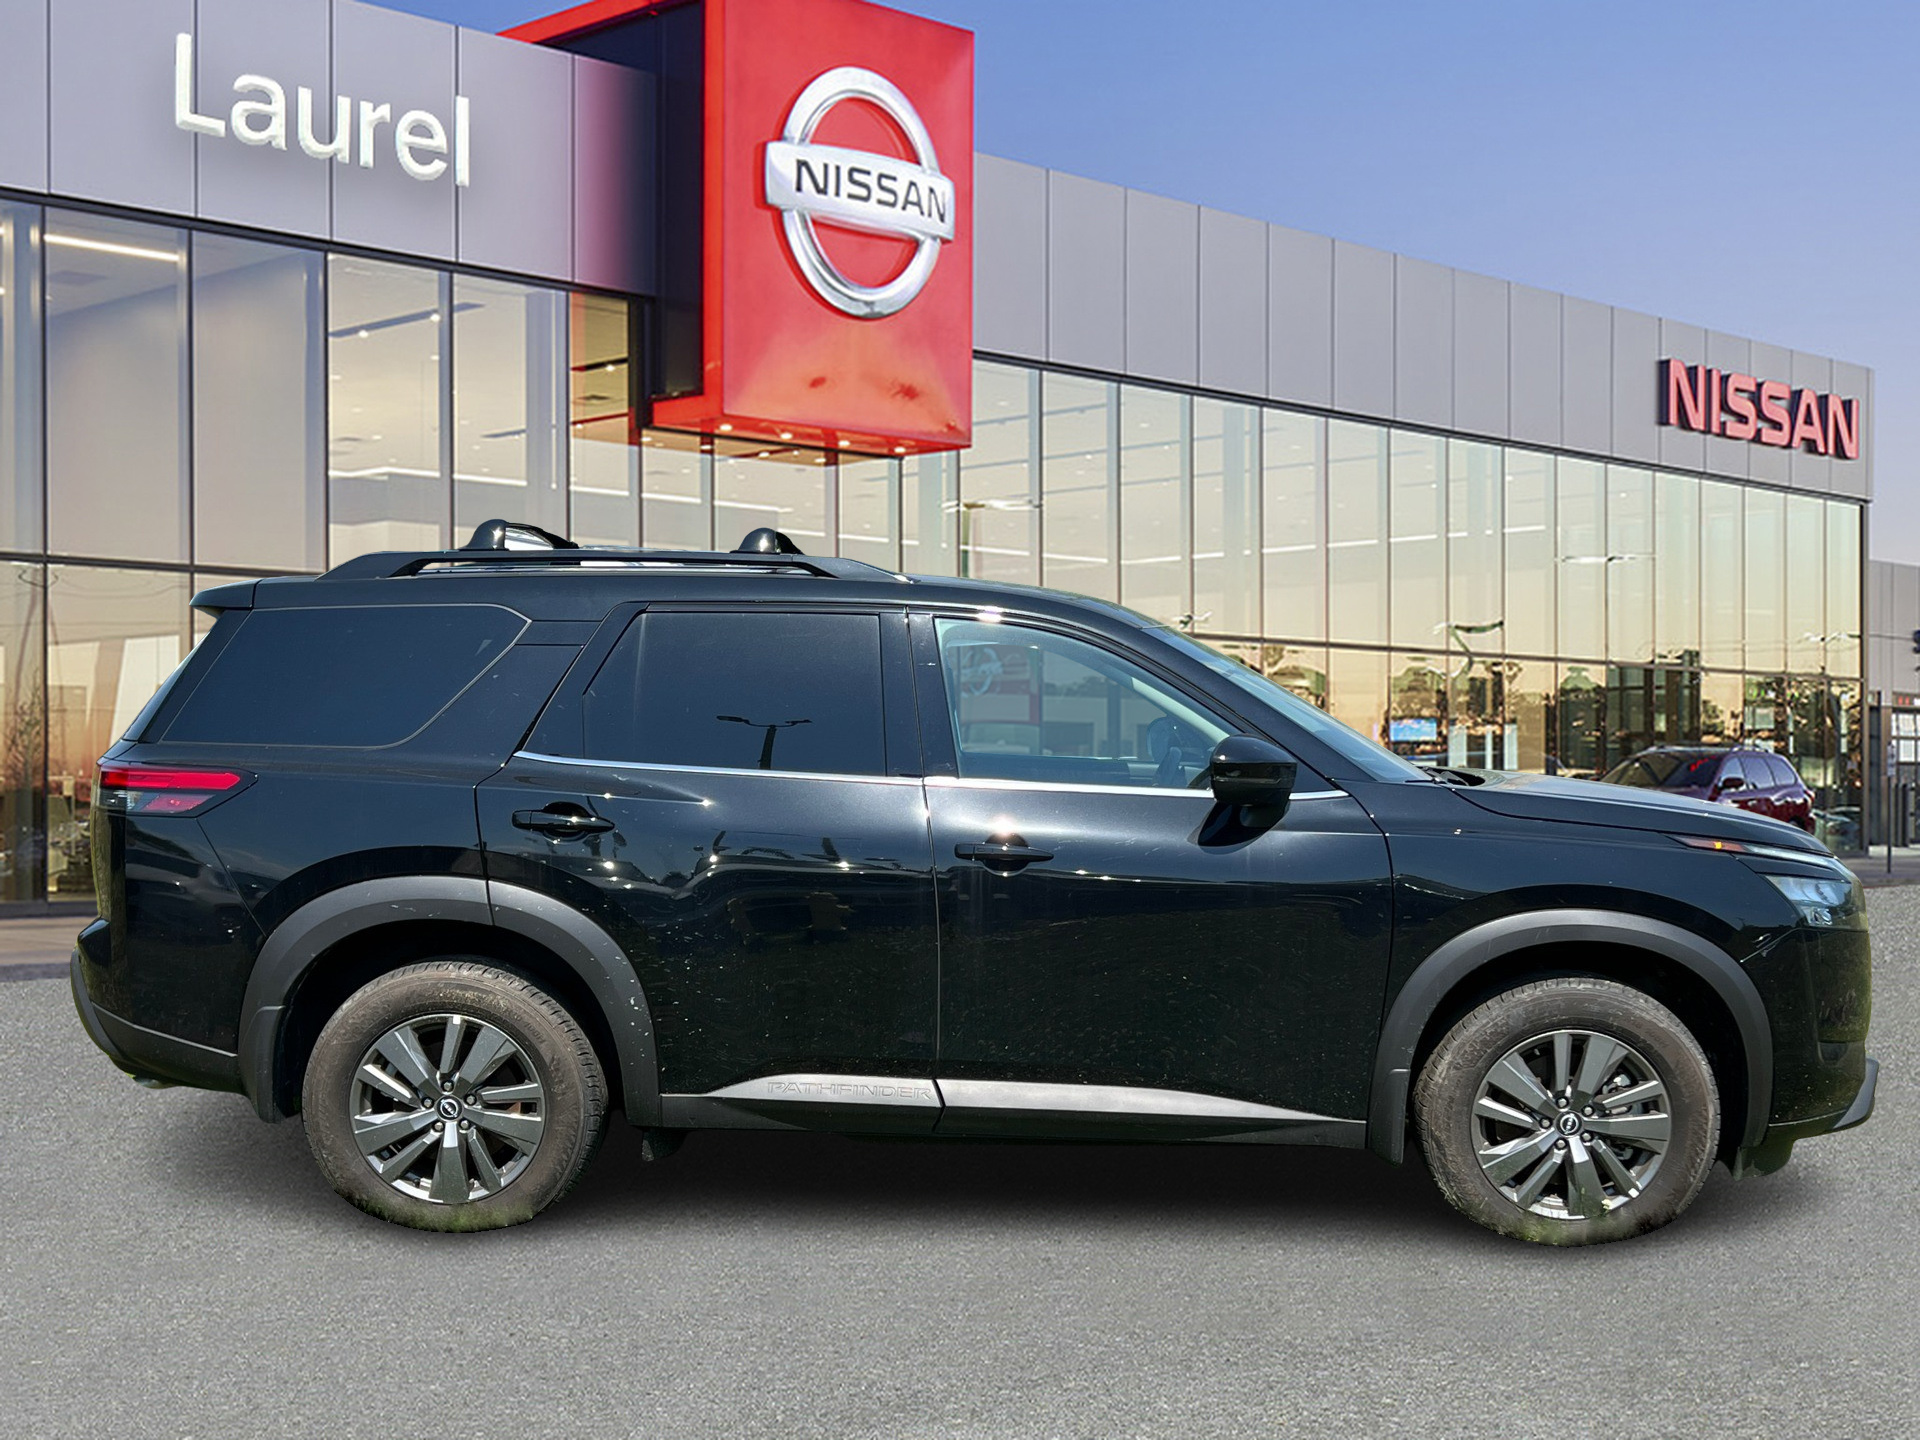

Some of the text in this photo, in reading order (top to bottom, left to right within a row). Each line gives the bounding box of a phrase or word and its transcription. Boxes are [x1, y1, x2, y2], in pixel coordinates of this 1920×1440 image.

[175, 32, 470, 188] Laurel
[795, 158, 947, 224] NISSAN
[1660, 358, 1860, 460] NISSAN
[767, 1081, 932, 1100] PATHFINDER
